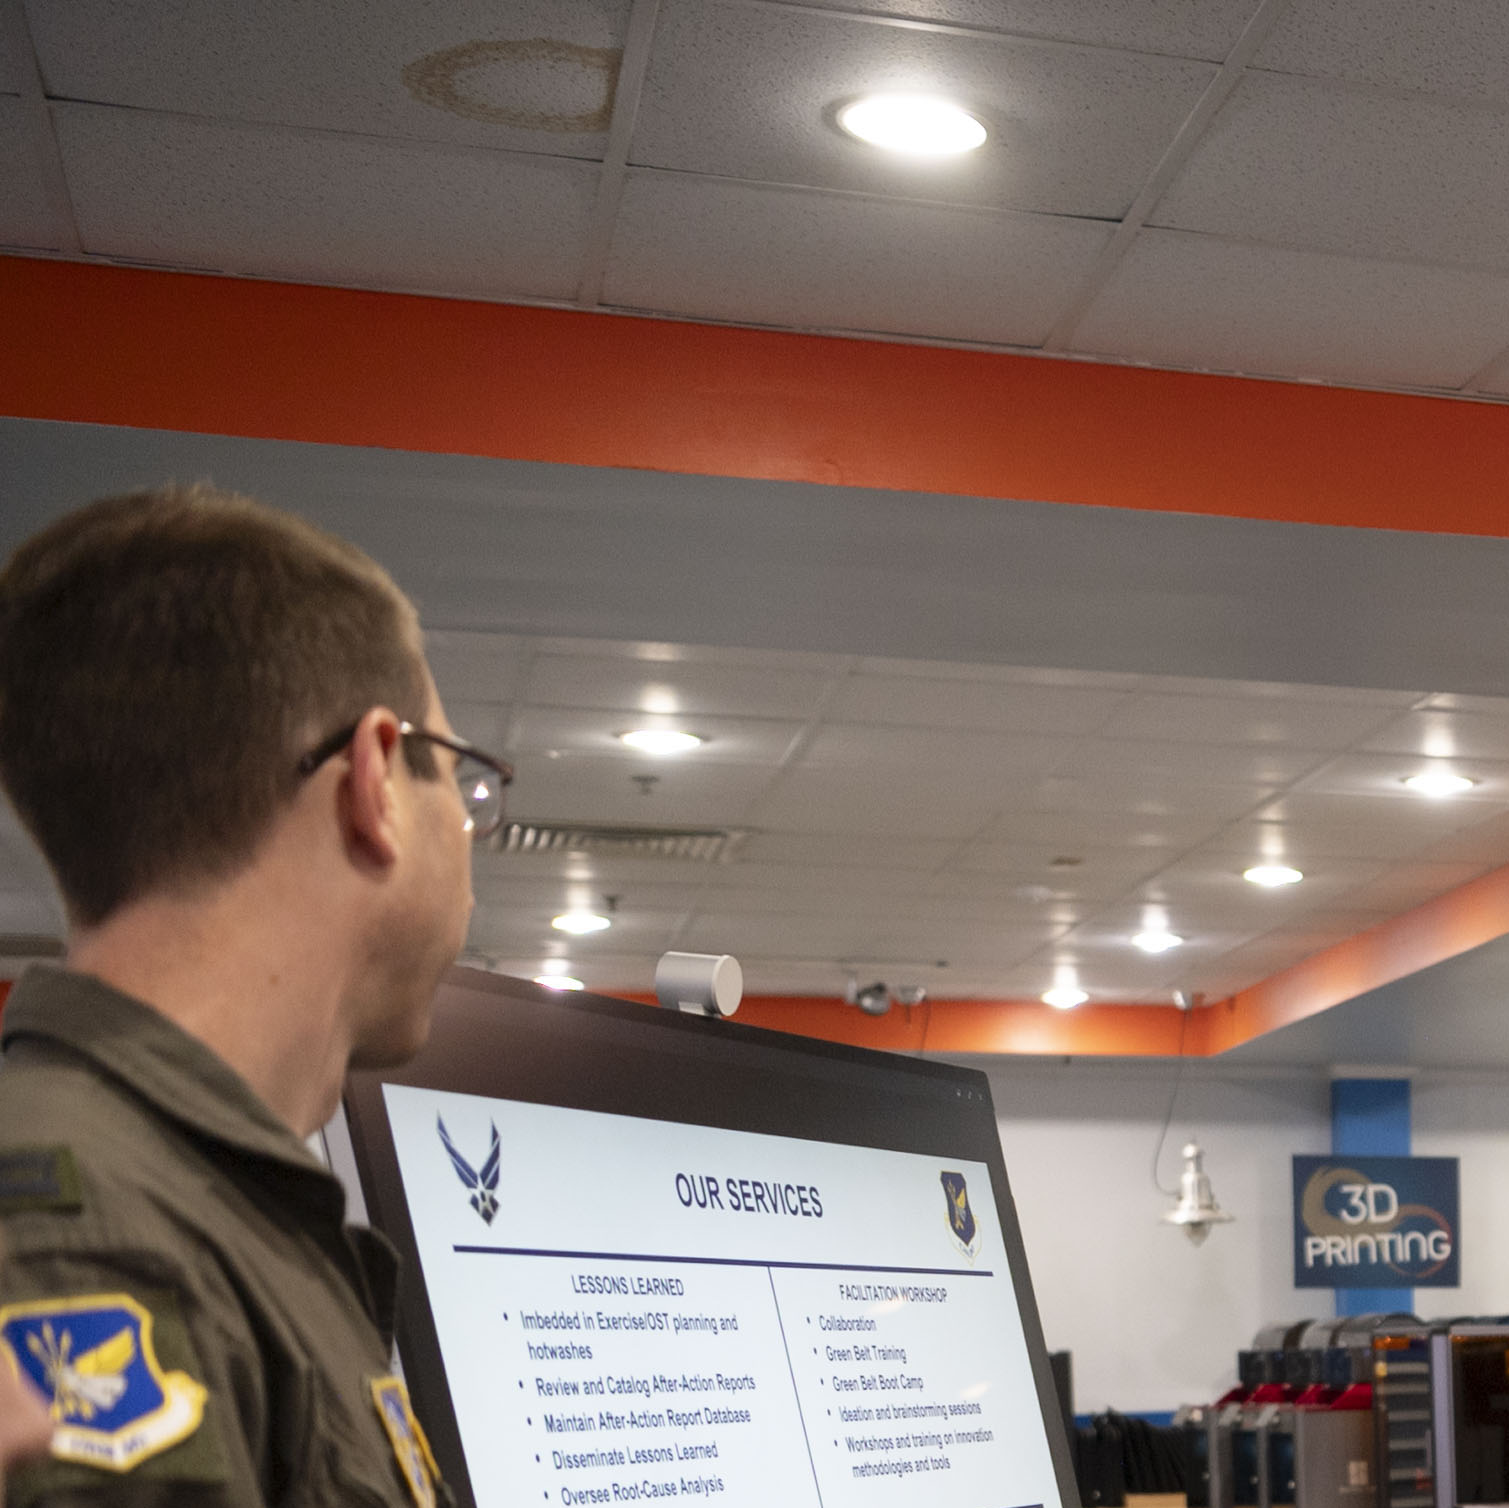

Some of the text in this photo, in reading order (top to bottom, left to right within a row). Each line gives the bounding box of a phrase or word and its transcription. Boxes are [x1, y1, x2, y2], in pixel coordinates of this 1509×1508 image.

[675, 1172, 824, 1218] OUR SERVICES
[1339, 1183, 1398, 1225] 3D
[571, 1274, 684, 1296] LESSONS LEARNED
[839, 1284, 948, 1303] FACILITATION WORKSHOP
[520, 1310, 739, 1336] Imbedded in Exercise/OST planning and
[819, 1314, 876, 1332] Collaboration
[526, 1341, 593, 1360] hotwashes
[825, 1345, 907, 1364] Green Belt Training
[535, 1373, 756, 1398] Review and Catalog After-Action Reports
[832, 1373, 924, 1392] Green Belt Boot Camp
[543, 1407, 751, 1433] Maintain After-Action Report Database
[838, 1402, 982, 1422] Ideation and brainstorming sessions
[845, 1428, 994, 1454] Workshops and training on innovation
[552, 1440, 719, 1470] Disseminate Lessons Learned
[852, 1454, 951, 1478] methodologies and tools
[560, 1474, 725, 1507] Oversee Root-Cause Analysis
